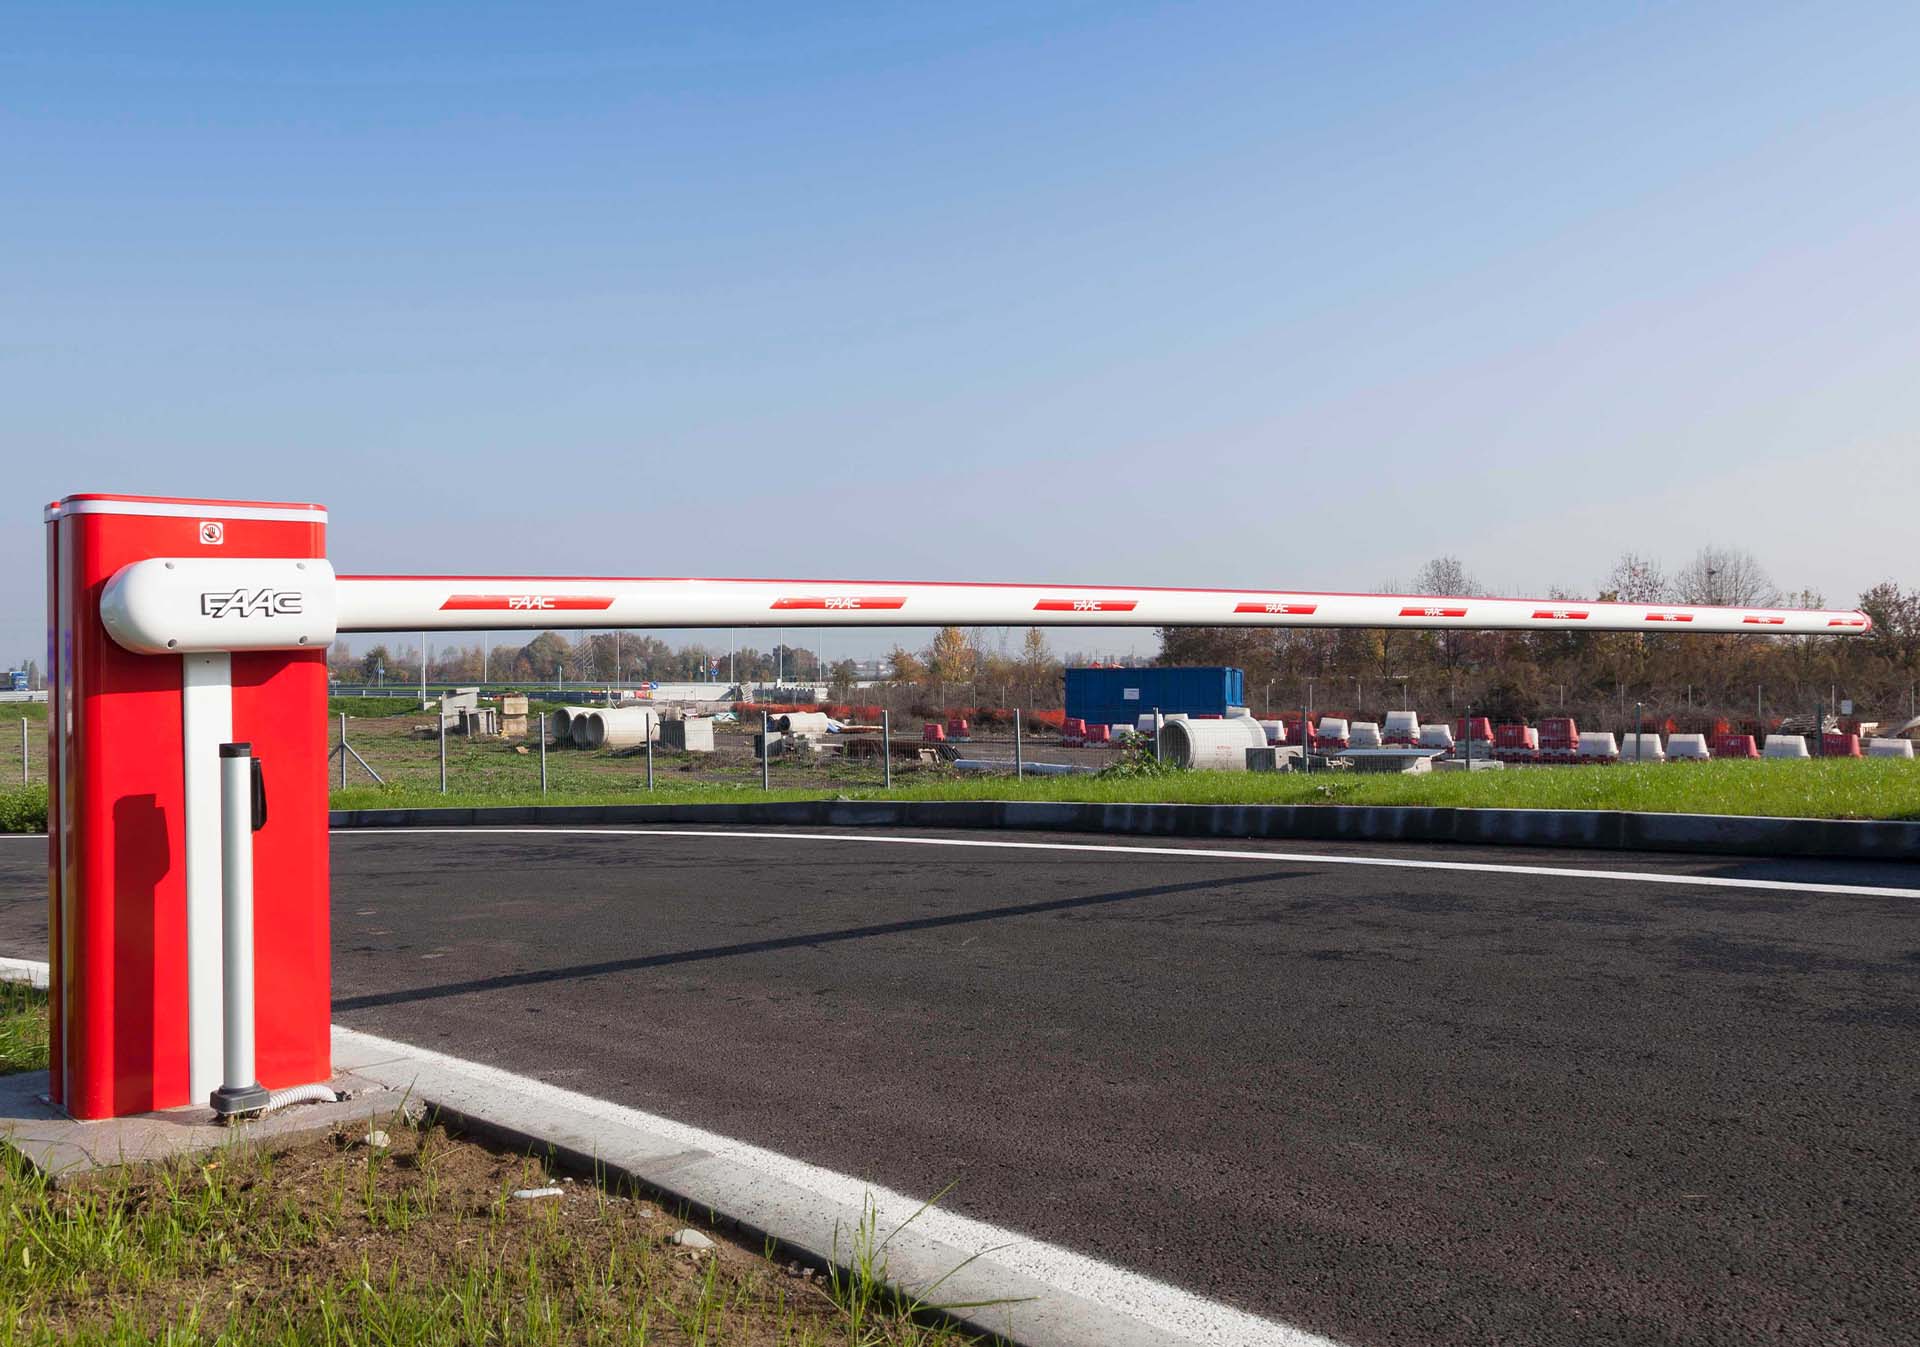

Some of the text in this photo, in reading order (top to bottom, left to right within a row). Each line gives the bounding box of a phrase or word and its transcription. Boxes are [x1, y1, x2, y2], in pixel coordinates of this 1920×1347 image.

[201, 588, 303, 619] FAAC
[508, 596, 555, 610] FAAC
[824, 598, 861, 609] FAAC
[1073, 600, 1102, 611] FAAC
